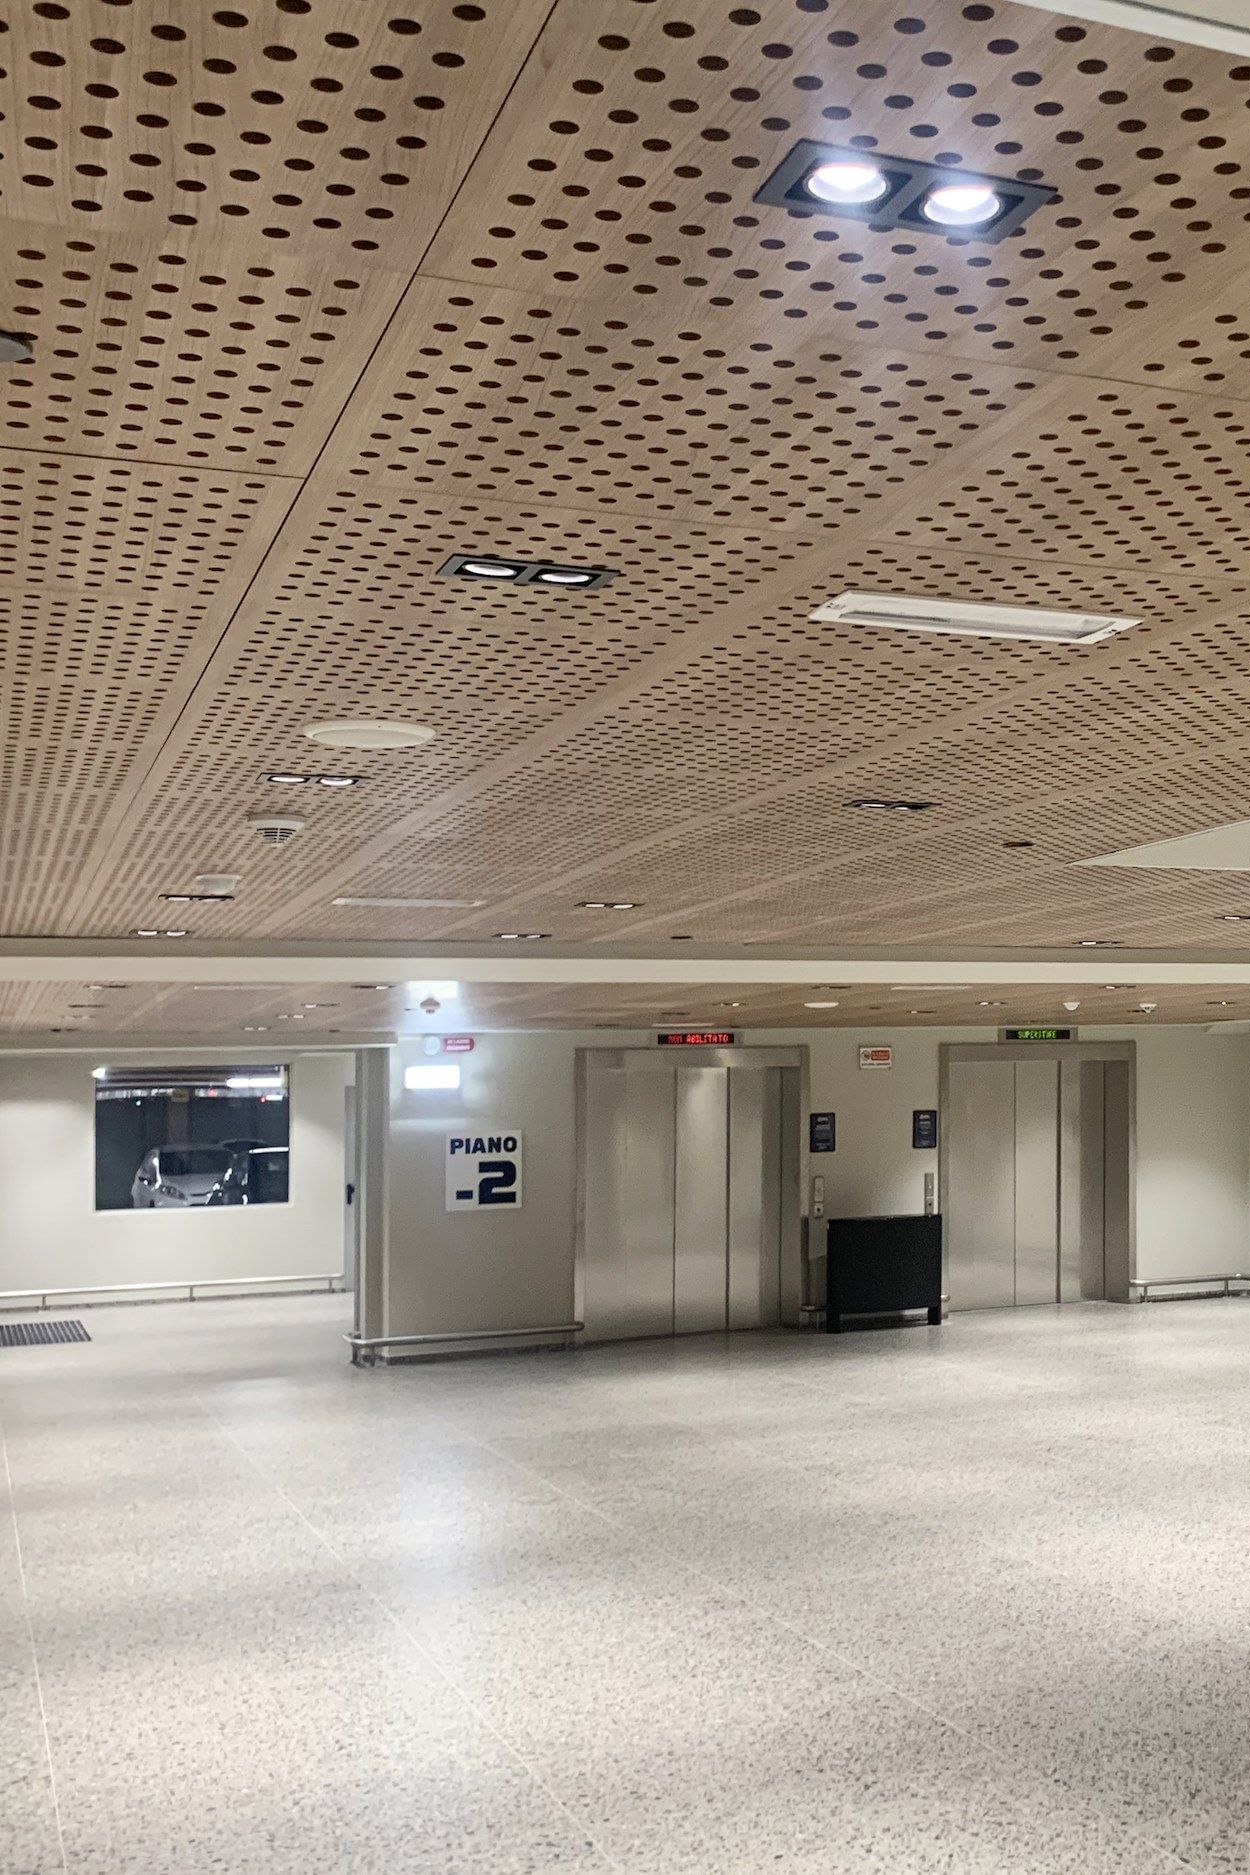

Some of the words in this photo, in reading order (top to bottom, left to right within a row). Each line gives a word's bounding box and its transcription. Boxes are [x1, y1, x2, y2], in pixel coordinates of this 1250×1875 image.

[686, 1033, 729, 1044] ABILITATO
[450, 1136, 517, 1155] PIANO
[456, 1161, 517, 1205] -2
